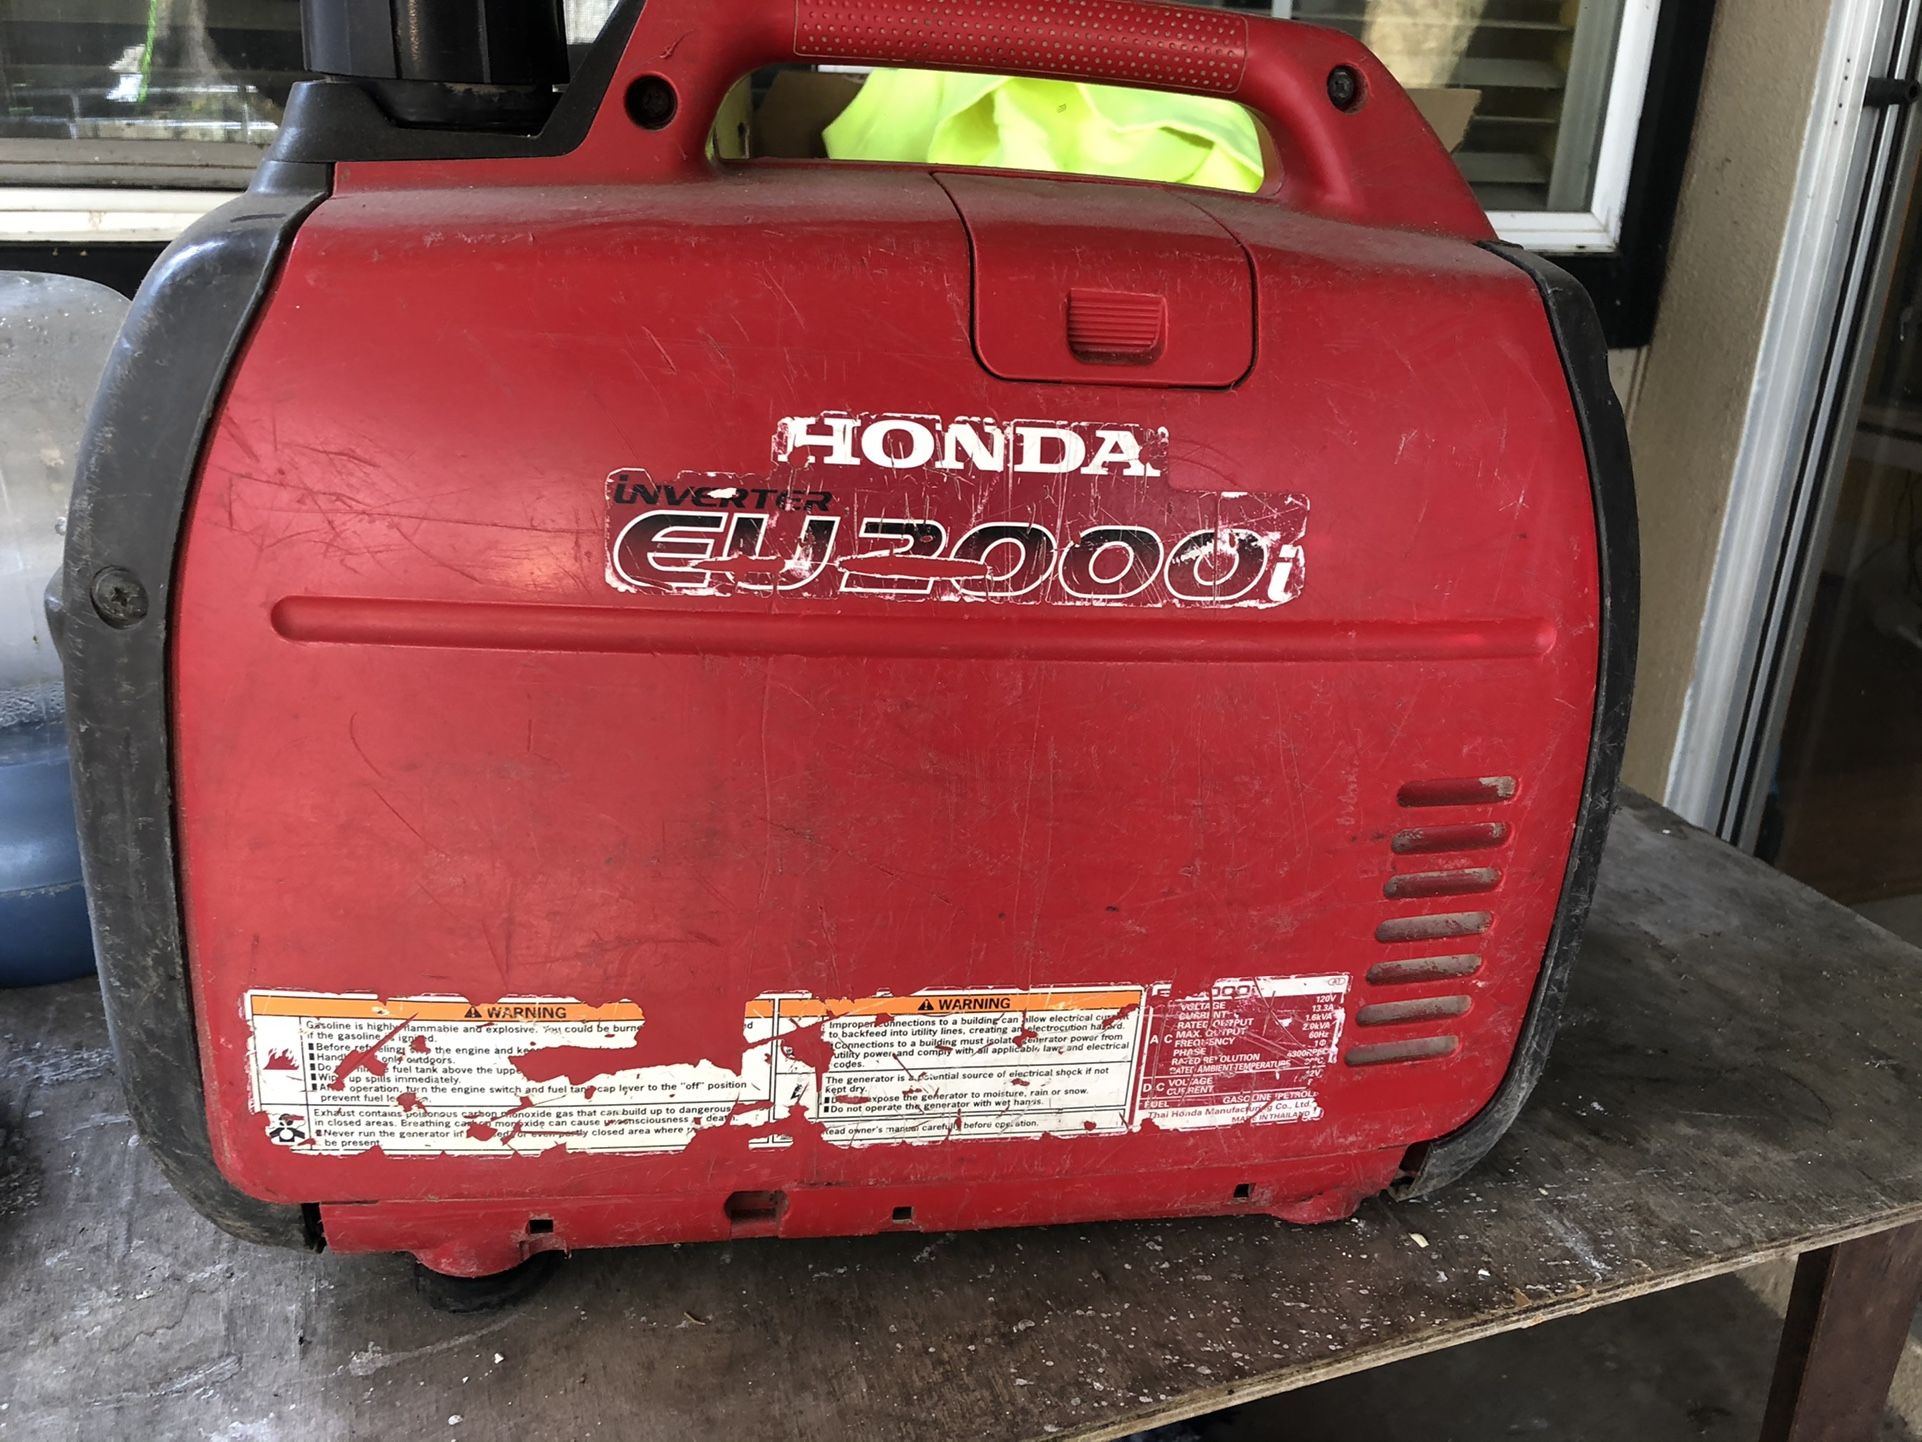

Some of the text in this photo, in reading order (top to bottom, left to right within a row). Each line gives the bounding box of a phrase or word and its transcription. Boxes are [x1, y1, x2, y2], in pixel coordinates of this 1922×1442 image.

[783, 416, 1160, 477] HONDA
[613, 510, 1303, 601] EU2000i
[1316, 994, 1337, 1003] 120V
[939, 998, 1010, 1010] WARNING
[1180, 1001, 1226, 1011] VOLTAGE
[1312, 1004, 1335, 1012] 13.3A
[487, 1006, 567, 1019] WARNING
[1305, 1013, 1332, 1022] 1.6kVA
[829, 1020, 875, 1029] Improper
[961, 1017, 998, 1026] building
[1050, 1013, 1093, 1021] electrical
[306, 1020, 351, 1030] Gasoline
[355, 1022, 363, 1030] is
[486, 1026, 538, 1035] explosive.
[565, 1025, 593, 1033] could
[597, 1024, 609, 1032] be
[842, 1030, 887, 1038] backfeed
[912, 1028, 938, 1037] utility
[941, 1026, 966, 1035] lines,
[969, 1026, 1008, 1034] creating
[1028, 1023, 1087, 1033] electrocution
[338, 1033, 381, 1041] gasoline
[1150, 1034, 1173, 1044] A C
[1176, 1030, 1202, 1039] MAX.
[1308, 1030, 1329, 1039] 60Hz
[835, 1041, 894, 1050] Connections
[919, 1038, 957, 1048] building
[960, 1038, 983, 1046] must
[1071, 1035, 1097, 1043] power
[1102, 1033, 1123, 1041] from
[317, 1043, 351, 1051] Before
[435, 1046, 451, 1054] the
[455, 1047, 490, 1055] engine
[494, 1046, 513, 1054] and
[835, 1051, 860, 1060] utility
[864, 1051, 892, 1060] power
[897, 1049, 914, 1057] and
[918, 1048, 951, 1057] comply
[977, 1046, 988, 1054] all
[1087, 1042, 1129, 1050] electrical
[1173, 1047, 1207, 1056] PHASE
[382, 1056, 455, 1065] only outdoors.
[834, 1061, 864, 1069] codes.
[442, 1066, 474, 1074] above
[366, 1075, 391, 1083] spills
[395, 1075, 461, 1085] immediately.
[826, 1076, 843, 1084] The
[847, 1075, 894, 1085] generator
[1009, 1069, 1053, 1078] electrical
[1056, 1068, 1082, 1076] shock
[1086, 1067, 1092, 1075] if
[349, 1084, 402, 1093] operation,
[406, 1085, 427, 1093] turn
[431, 1085, 447, 1093] the
[451, 1086, 485, 1095] engine
[525, 1086, 544, 1094] and
[548, 1085, 567, 1093] fuel
[597, 1086, 615, 1094] cap
[619, 1085, 644, 1093] lever
[661, 1083, 677, 1091] the
[708, 1081, 747, 1090] position
[825, 1085, 867, 1094] kept dry.
[1143, 1082, 1165, 1092] D C
[321, 1094, 360, 1102] prevent
[903, 1093, 918, 1101] the
[921, 1092, 968, 1102] generator
[983, 1089, 1027, 1098] moisture,
[1030, 1088, 1048, 1096] rain
[830, 1105, 844, 1113] Do
[847, 1104, 862, 1112] not
[865, 1103, 902, 1112] operate
[905, 1102, 920, 1110] the
[924, 1101, 970, 1111] generator
[995, 1099, 1010, 1107] wet
[1144, 1099, 1169, 1108] FUEL
[314, 1108, 355, 1117] Exhaust
[359, 1109, 402, 1117] contains
[556, 1111, 573, 1119] gas
[577, 1109, 596, 1117] that
[622, 1108, 647, 1116] build
[650, 1108, 662, 1117] up
[679, 1106, 731, 1115] dangerous
[1148, 1110, 1169, 1119] Thai
[1171, 1108, 1203, 1117] Honda
[1260, 1113, 1269, 1121] IN
[328, 1119, 361, 1127] closed
[401, 1120, 453, 1129] Breathing
[848, 1121, 992, 1135] owner's before
[324, 1129, 354, 1137] Never
[400, 1130, 449, 1139] generator
[592, 1128, 624, 1136] closed
[628, 1127, 650, 1135] area
[654, 1126, 683, 1134] where
